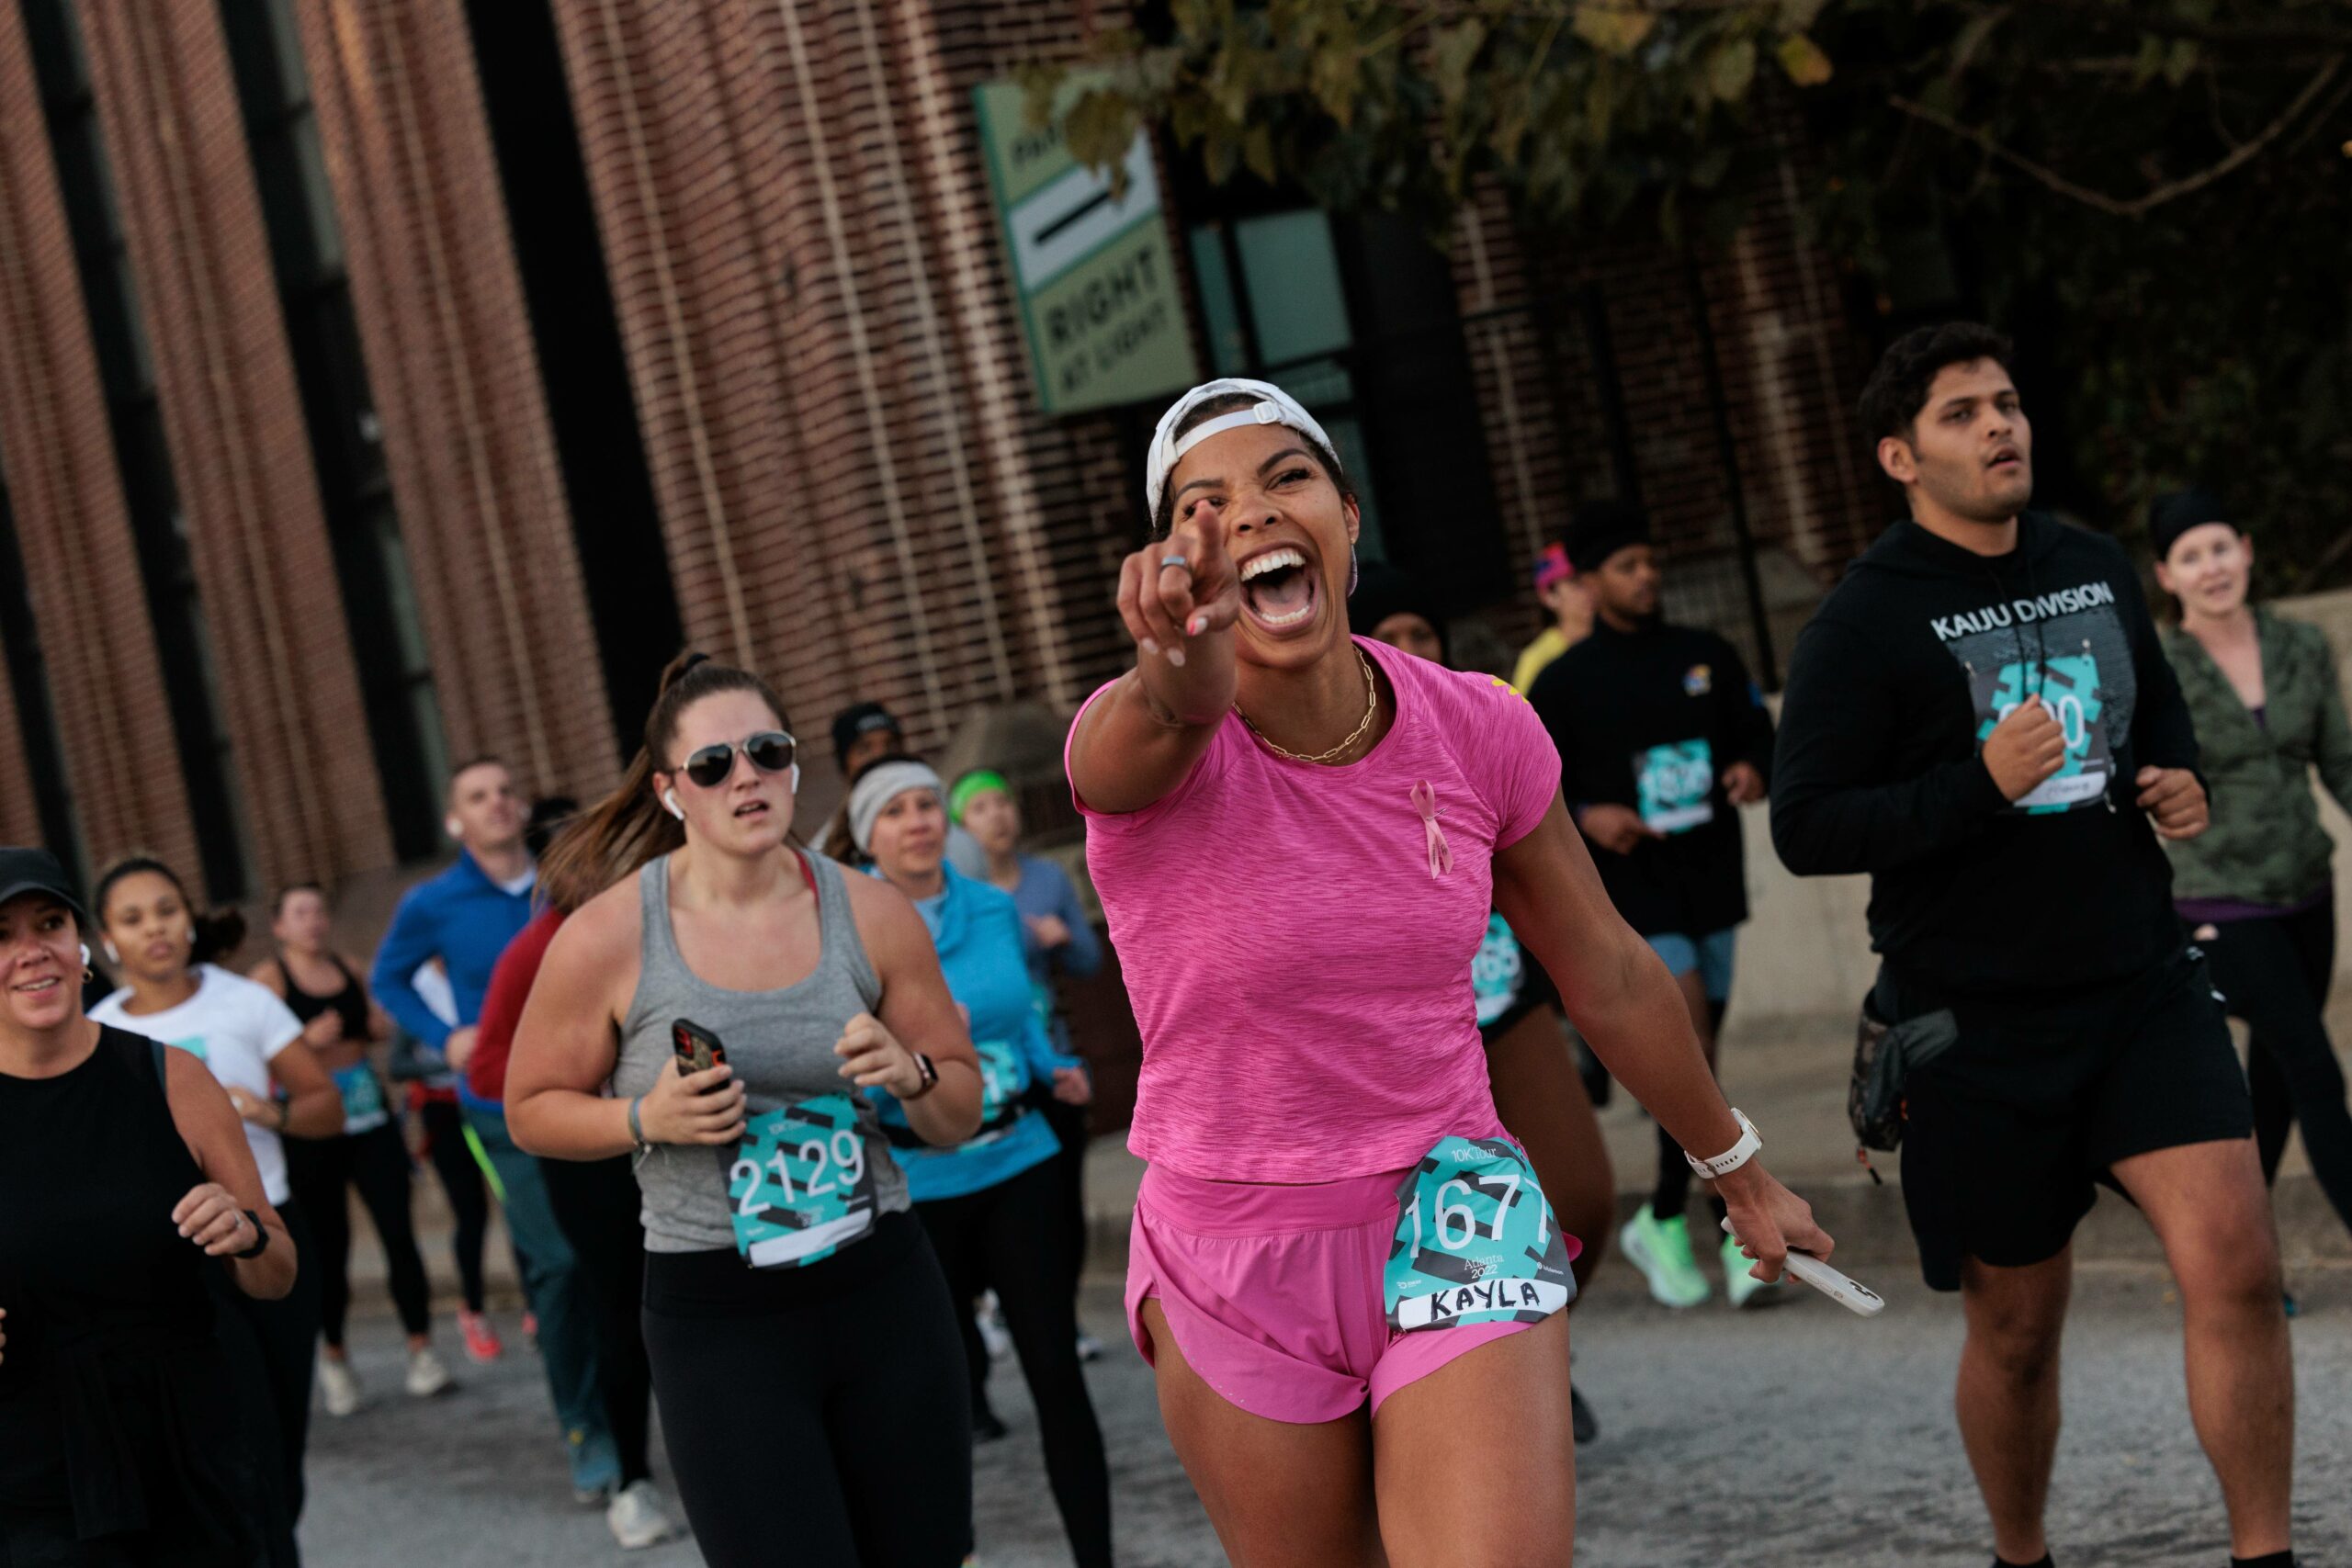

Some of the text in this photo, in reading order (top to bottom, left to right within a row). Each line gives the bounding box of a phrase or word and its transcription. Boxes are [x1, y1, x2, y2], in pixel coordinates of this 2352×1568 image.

[1046, 246, 1157, 349] RIGHT
[1096, 303, 1166, 369] LIGHT
[1930, 581, 2116, 641] KAIJU DIVISION
[729, 1129, 865, 1217] 2129
[1452, 1145, 1497, 1163] 10K Tour
[1464, 1254, 1505, 1270] Atlanta
[1471, 1264, 1498, 1280] 2022
[1430, 1279, 1541, 1321] KAYLA
